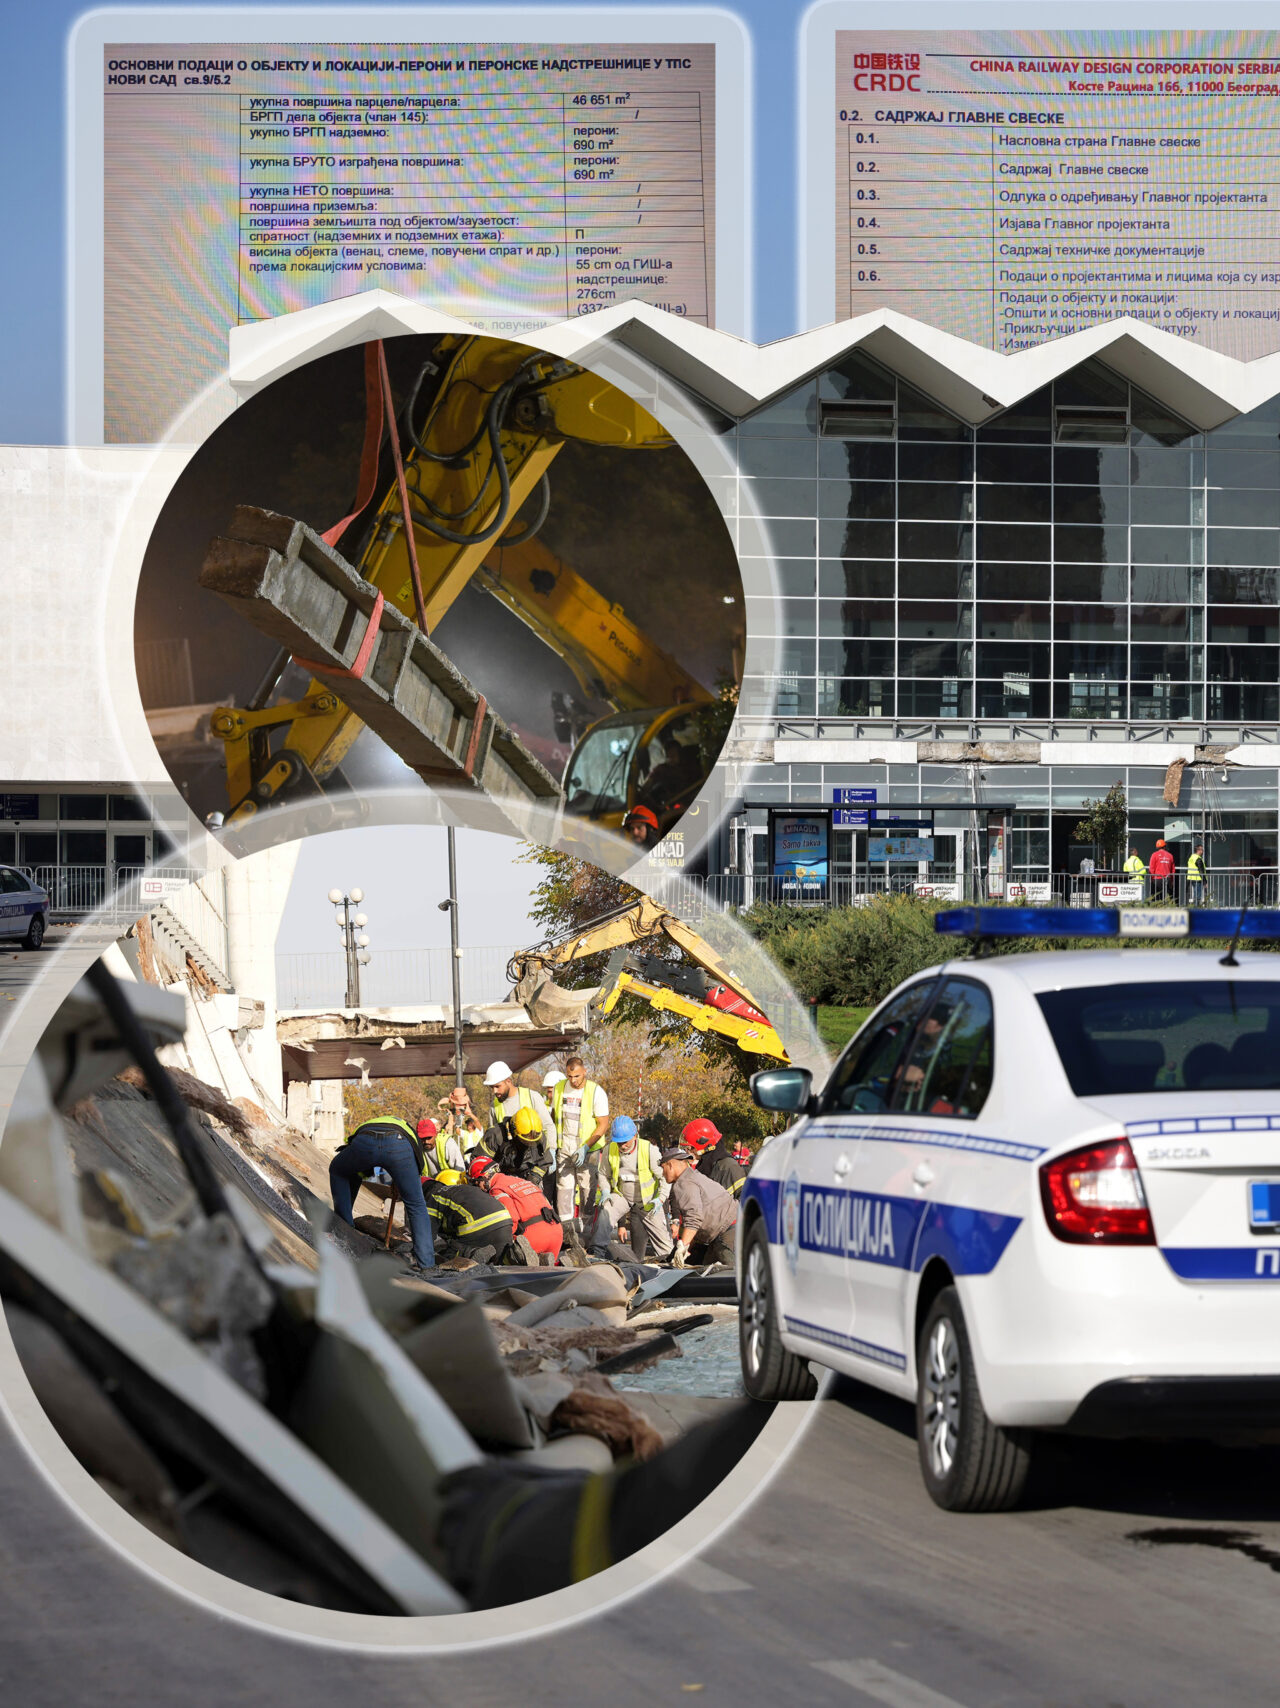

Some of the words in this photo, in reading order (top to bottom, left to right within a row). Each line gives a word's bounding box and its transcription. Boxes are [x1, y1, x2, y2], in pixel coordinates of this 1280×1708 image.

[108, 60, 174, 71] ОСНОВНИ
[178, 60, 234, 74] ПОДАЦИ
[237, 60, 248, 71] О
[251, 60, 309, 71] ОБЈЕКТУ
[312, 61, 322, 71] И
[325, 60, 451, 73] ЛОКАЦИЈИ-ПЕРОНИ
[457, 60, 465, 71] И
[469, 60, 538, 71] ПЕРОНСКЕ
[542, 59, 651, 72] НАДСТРЕШНИЦЕ
[654, 59, 662, 69] У
[665, 59, 691, 69] ТПС
[853, 53, 920, 71] 中国铁设
[970, 60, 1014, 72] CHINA
[1018, 61, 1079, 73] RAILWAY
[1083, 62, 1132, 74] DESIGN
[1136, 63, 1234, 75] CORPORATION
[108, 75, 146, 86] НОВИ
[149, 75, 177, 87] САД
[184, 75, 231, 85] св.9/5.2
[854, 73, 921, 92] CRDC
[1068, 81, 1104, 92] Косте
[1108, 82, 1154, 94] Рацина
[1158, 82, 1183, 93] 166,
[1188, 82, 1224, 92] 11000
[250, 98, 289, 108] укупна
[292, 97, 352, 108] површина
[572, 95, 587, 105] 46
[590, 95, 611, 105] 651
[250, 112, 283, 122] БРГП
[286, 112, 315, 123] дела
[319, 111, 362, 124] објекта
[365, 112, 397, 124] (члан
[839, 111, 863, 122] 0.2.
[875, 110, 944, 124] САДРЖАЈ
[948, 112, 1004, 124] ГЛАВНЕ
[1008, 113, 1065, 124] СВЕСКЕ
[250, 128, 290, 139] укупно
[292, 128, 326, 137] БРГП
[329, 128, 389, 139] надземно:
[573, 126, 619, 137] перони:
[573, 139, 594, 150] 690
[856, 133, 880, 144] 0.1.
[999, 135, 1060, 146] Насловна
[1065, 138, 1107, 149] страна
[1111, 135, 1156, 147] Главне
[1159, 137, 1201, 147] свеске
[250, 158, 290, 168] укупна
[292, 157, 335, 167] БРУТО
[339, 157, 398, 169] изграђена
[402, 157, 464, 168] површина:
[574, 155, 619, 166] перони:
[574, 169, 595, 180] 690
[856, 162, 880, 173] 0.2.
[999, 163, 1052, 177] Садржај
[1059, 164, 1104, 175] Главне
[1107, 165, 1149, 175] свеске
[250, 187, 289, 198] укупна
[292, 186, 329, 196] НЕТО
[332, 186, 394, 197] површина:
[856, 190, 880, 201] 0.3.
[1142, 192, 1191, 203] Главног
[1195, 193, 1268, 205] пројектанта
[250, 202, 309, 213] површина
[250, 217, 309, 228] површина
[313, 218, 376, 227] земљишта
[379, 217, 401, 228] под
[857, 217, 881, 228] 0.4.
[1000, 219, 1041, 231] Изјава
[1044, 219, 1093, 229] Главног
[1097, 220, 1170, 231] пројектанта
[250, 232, 309, 243] спратност
[313, 231, 382, 243] (надземних
[395, 231, 458, 242] подземних
[249, 248, 291, 257] висина
[295, 247, 338, 259] објекта
[431, 247, 487, 258] повучени
[489, 246, 522, 257] спрат
[575, 246, 622, 256] перони:
[857, 244, 881, 255] 0.5.
[1000, 244, 1052, 258] Садржај
[1056, 246, 1111, 256] техничке
[1114, 246, 1205, 258] документације
[249, 263, 286, 273] према
[290, 262, 363, 273] локацијским
[366, 262, 426, 273] условима:
[576, 259, 590, 269] 55
[614, 260, 630, 271] од
[857, 271, 881, 282] 0.6.
[1000, 271, 1048, 283] Подаци
[1062, 272, 1151, 284] пројектантима
[1166, 273, 1213, 284] лицима
[1217, 272, 1240, 285] која
[1244, 274, 1257, 285] су
[577, 289, 616, 299] 276cm
[1000, 293, 1047, 304] Подаци
[1062, 293, 1107, 305] објекту
[1061, 309, 1112, 318] основни
[1175, 307, 1219, 321] објекту
[786, 824, 818, 834] MINAQUA
[783, 839, 801, 849] Samo
[1123, 913, 1186, 927] ПОЛИЦИЈА
[803, 1191, 895, 1259] ПОЛИЦИЈА
